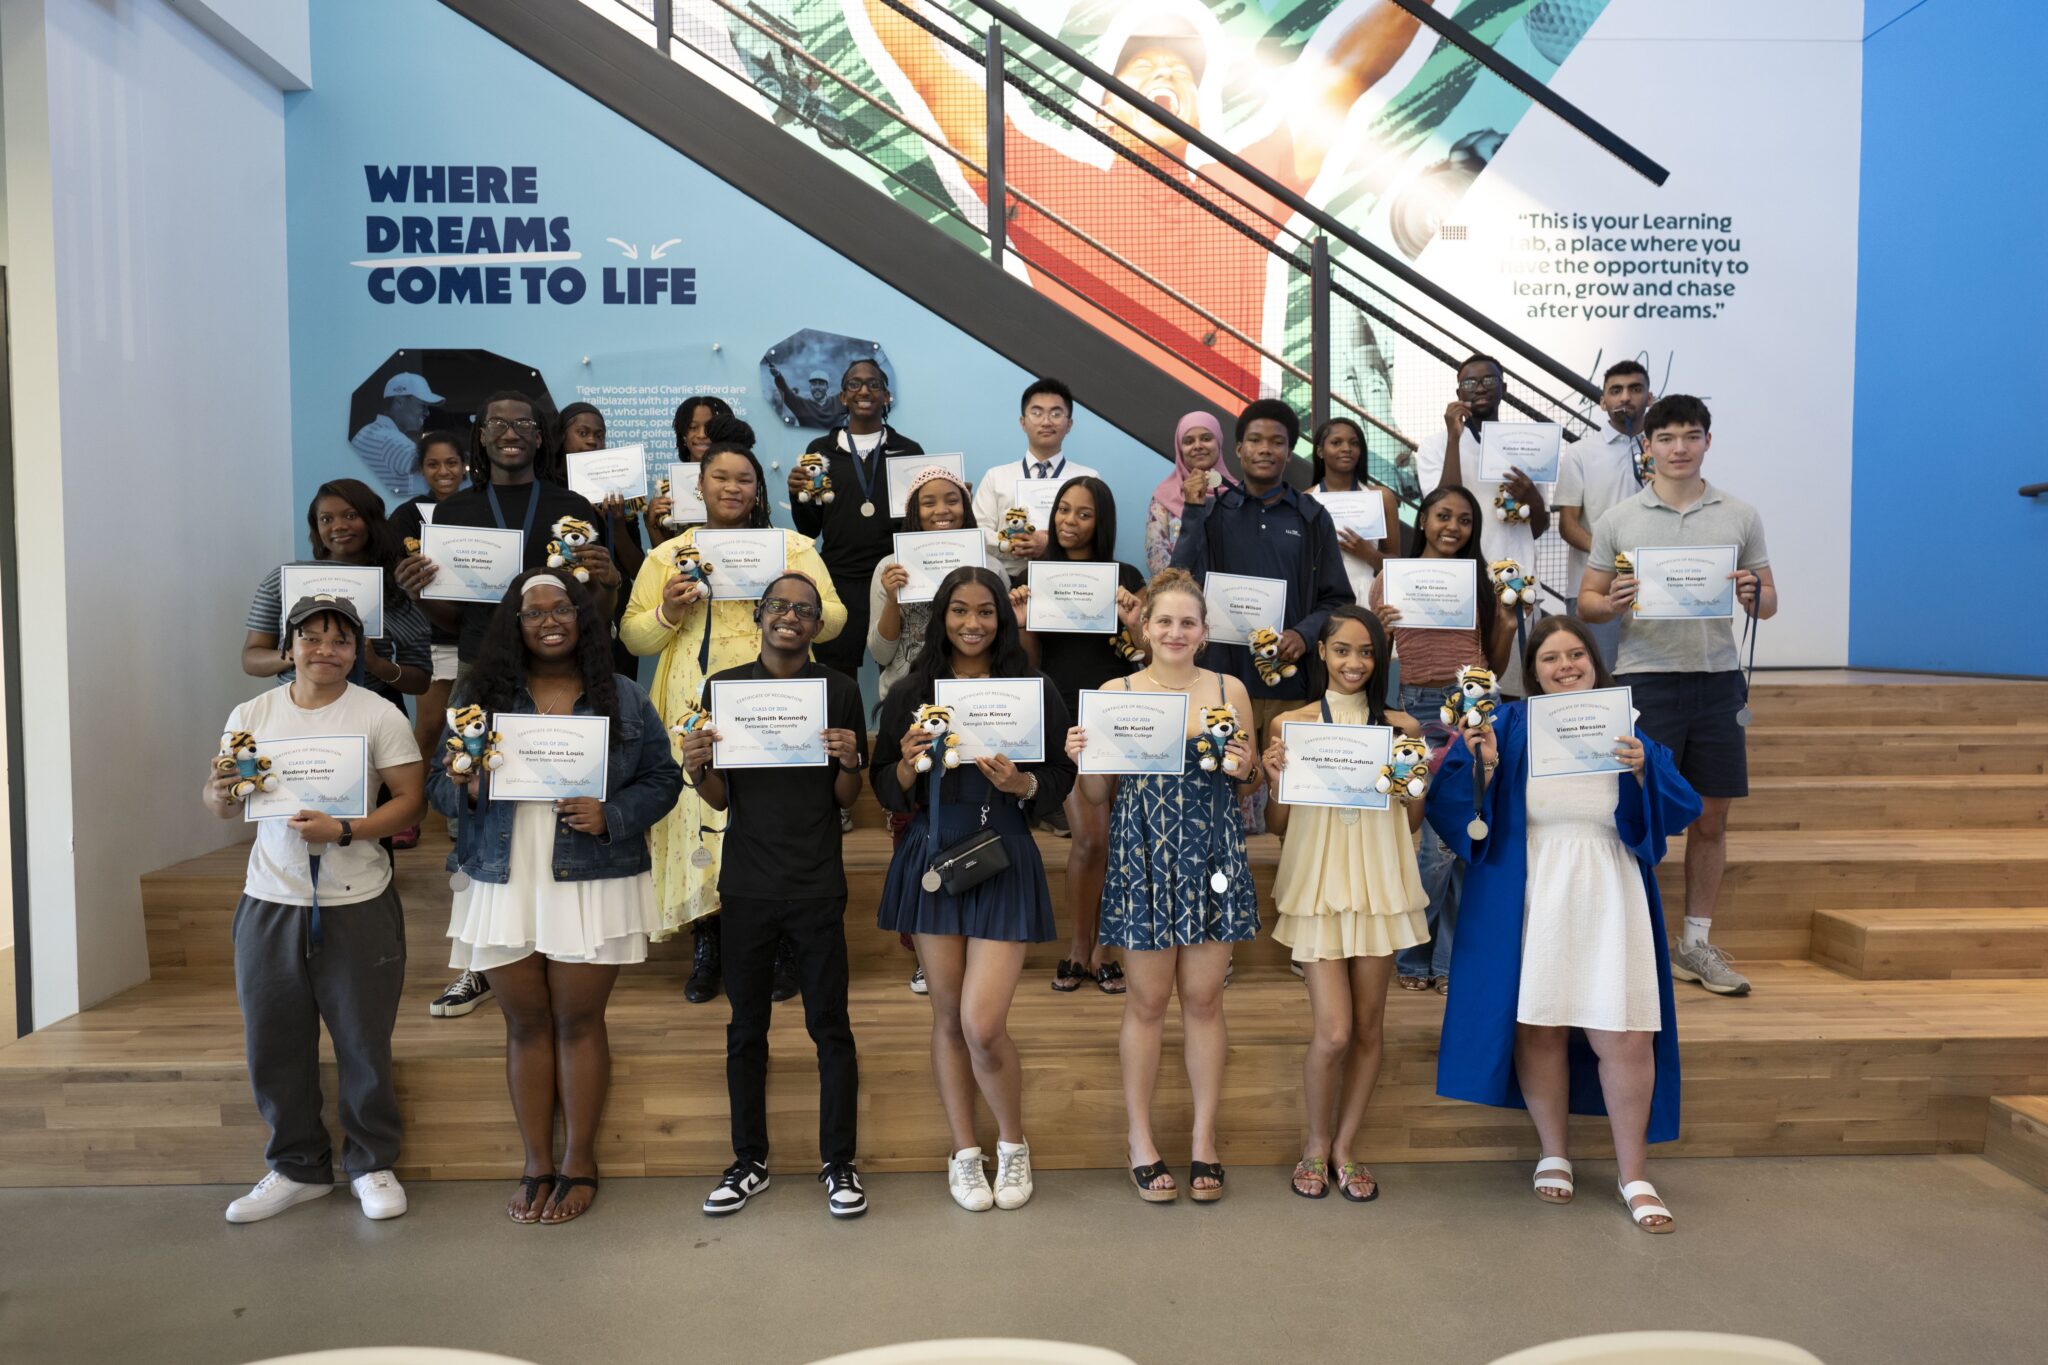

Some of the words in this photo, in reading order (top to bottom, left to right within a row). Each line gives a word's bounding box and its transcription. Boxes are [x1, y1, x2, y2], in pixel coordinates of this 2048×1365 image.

[364, 165, 538, 204] WHERE
[1573, 212, 1588, 229] is
[1591, 216, 1639, 232] your
[1643, 213, 1732, 233] Learning
[366, 216, 571, 254] DREAMS
[1555, 238, 1566, 251] a
[1571, 236, 1627, 254] place
[1630, 236, 1698, 252] where
[1701, 238, 1740, 255] you
[1555, 258, 1589, 273] the
[1594, 258, 1723, 277] opportunity
[1727, 259, 1749, 274] to
[368, 266, 512, 305] COME
[520, 267, 586, 305] TO
[602, 267, 697, 305] LIFE
[1513, 280, 1571, 298] learn,
[1575, 283, 1629, 299] grow
[1632, 280, 1672, 296] and
[1676, 280, 1736, 296] chase
[1527, 302, 1578, 318] after
[1582, 305, 1630, 321] your
[576, 385, 600, 396] Tiger
[601, 385, 637, 394] Woods
[639, 385, 658, 394] and
[660, 385, 693, 394] Charlie
[695, 385, 729, 394] Sifford
[582, 396, 637, 405] trailblazers
[639, 396, 658, 405] with
[615, 408, 637, 416] who
[639, 408, 669, 416] called
[612, 420, 649, 428] course,
[628, 430, 641, 438] of
[651, 440, 668, 449] TGR
[656, 451, 673, 460] the
